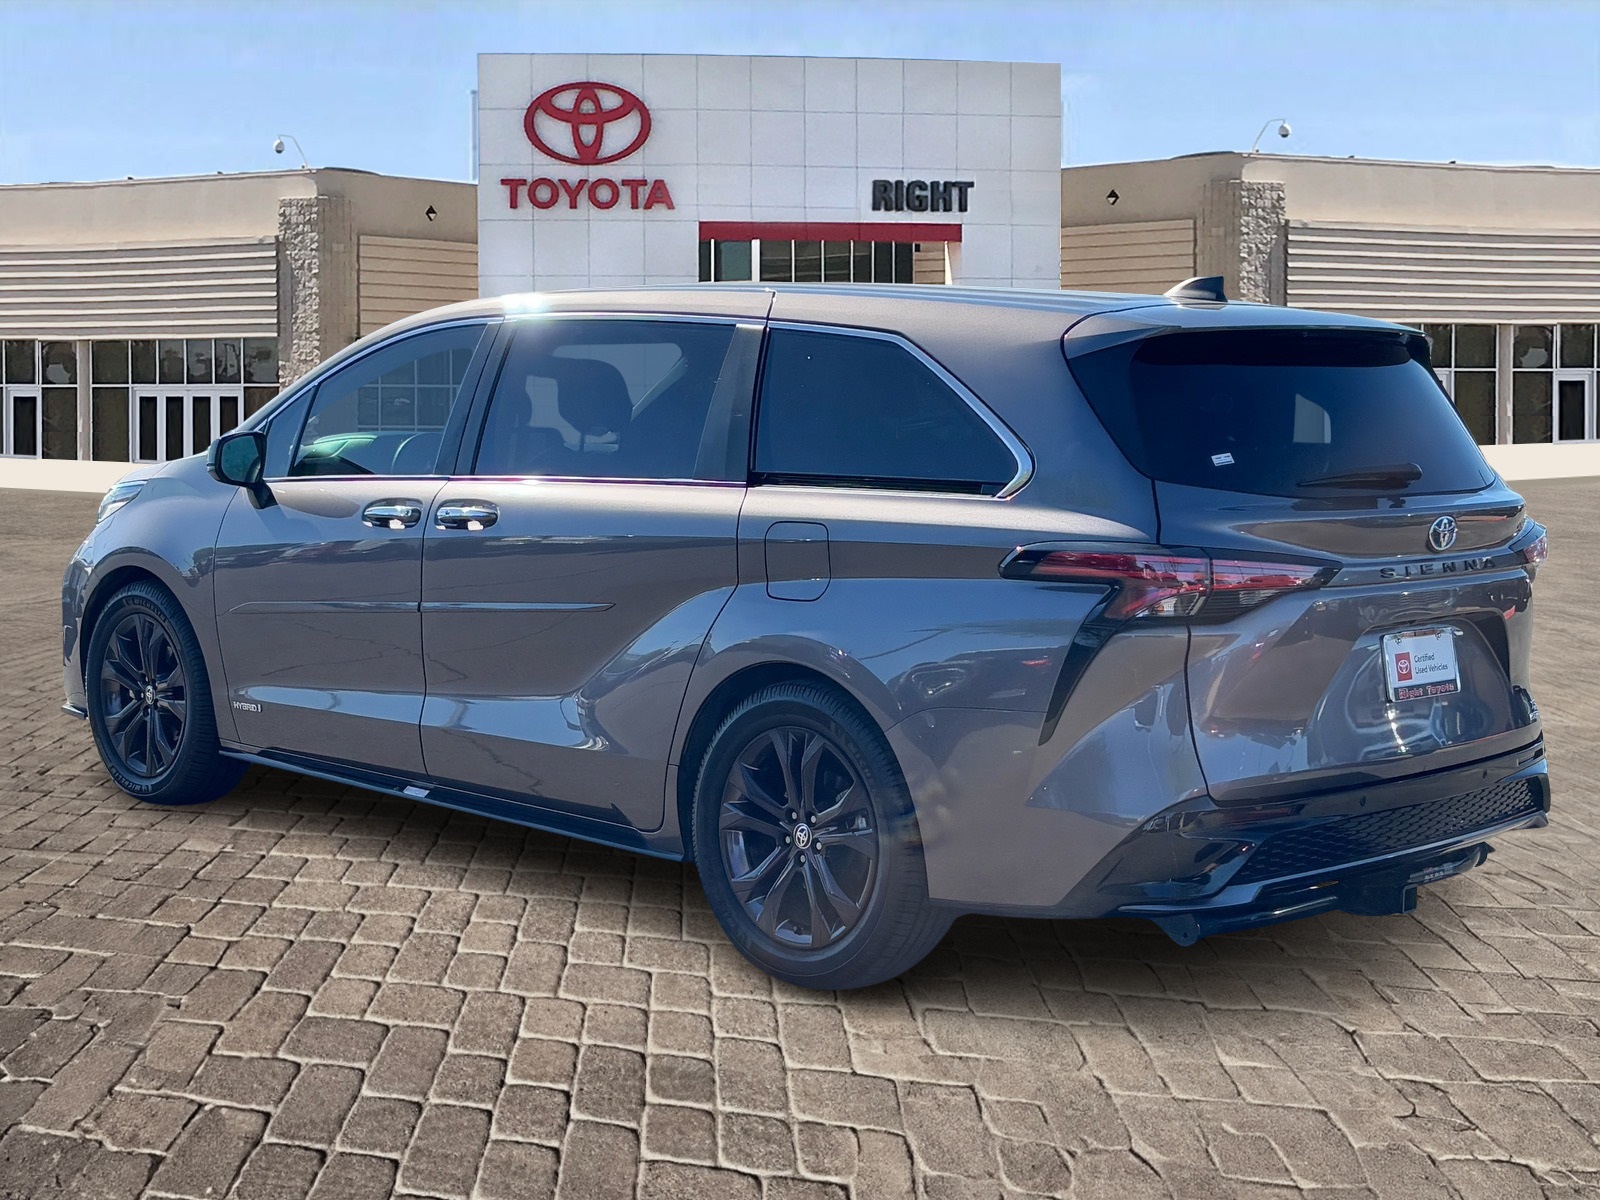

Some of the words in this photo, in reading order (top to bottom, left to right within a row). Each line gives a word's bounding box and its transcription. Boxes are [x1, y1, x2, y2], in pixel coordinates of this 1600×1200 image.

[500, 178, 675, 210] TOYOTA
[872, 179, 975, 213] RIGHT
[1380, 557, 1496, 579] SIENNA
[1413, 652, 1435, 663] Certified
[1415, 666, 1428, 675] Used
[1428, 663, 1449, 673] Vehicles
[1426, 683, 1455, 695] Toyota
[233, 701, 257, 711] HYBRID
